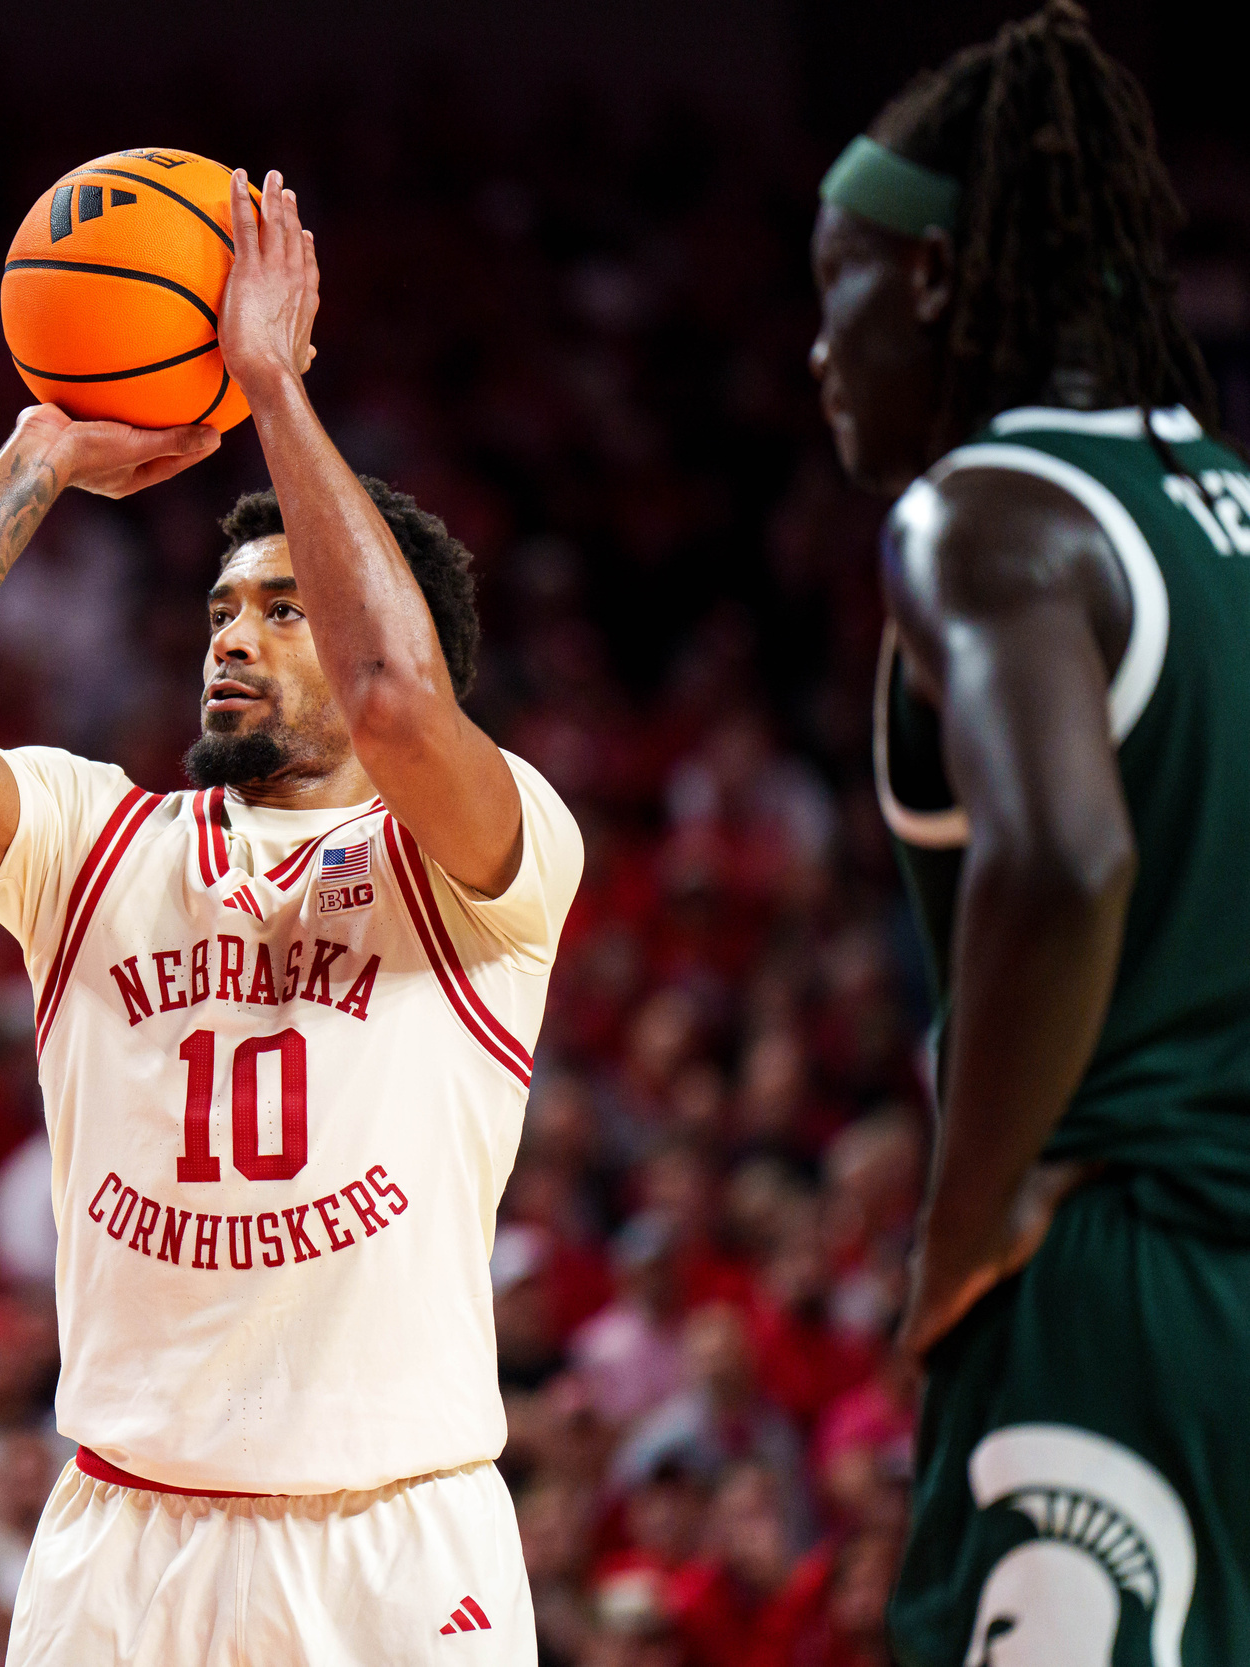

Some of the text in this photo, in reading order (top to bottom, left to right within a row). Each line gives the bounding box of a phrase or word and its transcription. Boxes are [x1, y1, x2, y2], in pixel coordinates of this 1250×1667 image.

[109, 934, 382, 1027] NEBRASKA
[176, 1027, 308, 1183] 10
[88, 1164, 410, 1270] CORNHUSKERS
